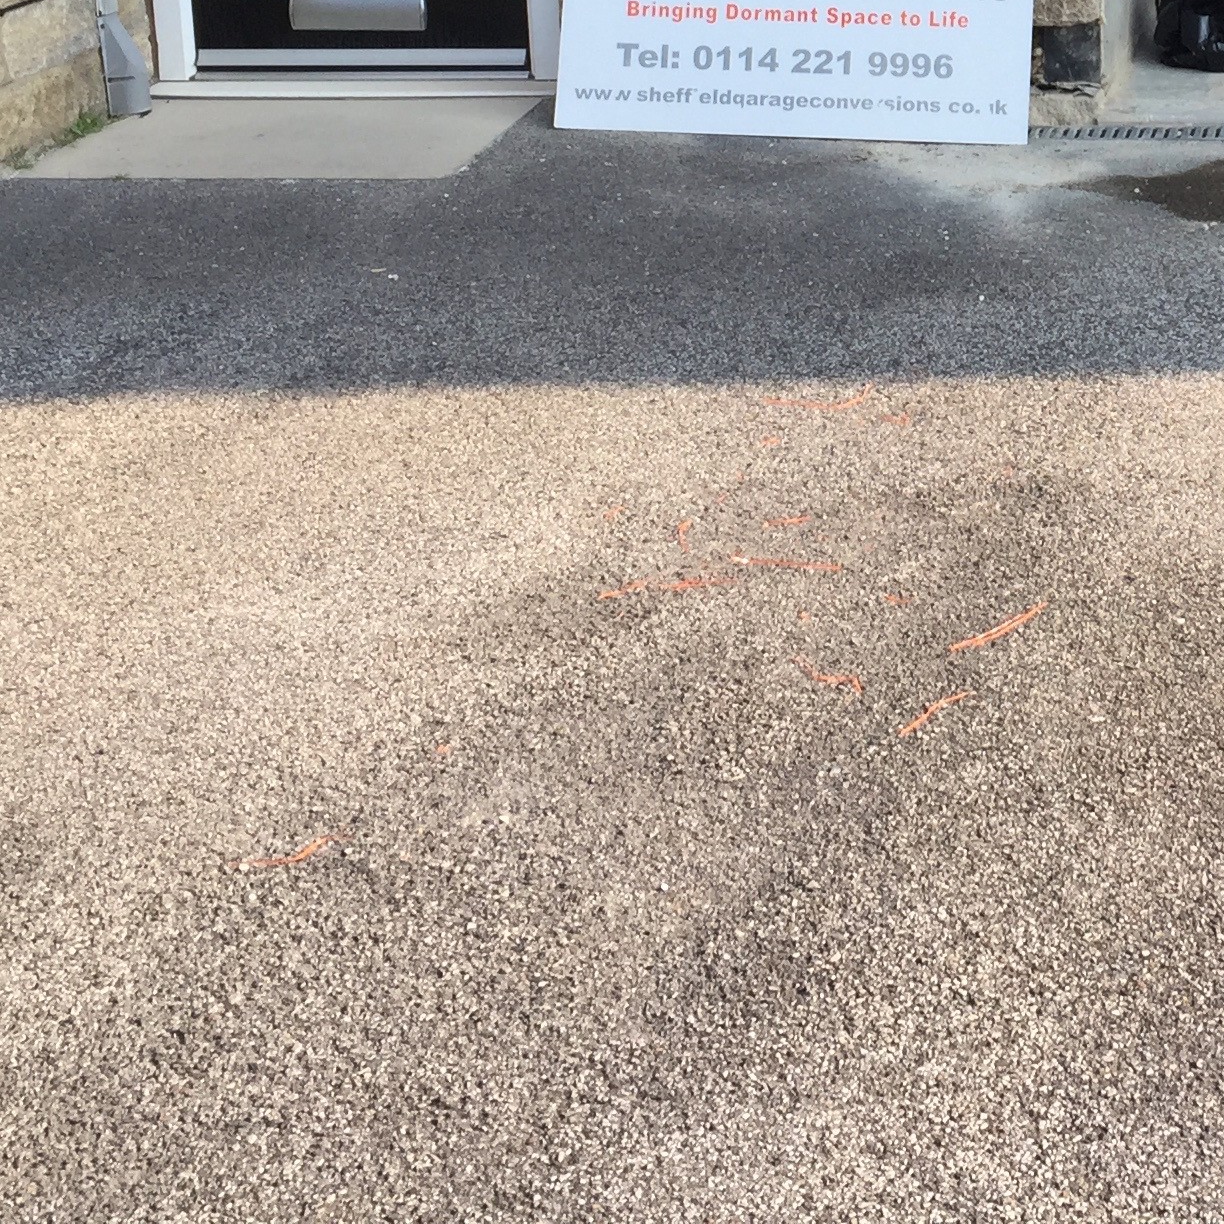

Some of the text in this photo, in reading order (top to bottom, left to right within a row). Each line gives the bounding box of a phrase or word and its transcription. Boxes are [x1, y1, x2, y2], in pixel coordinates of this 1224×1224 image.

[626, 0, 969, 29] Bringing Dormant Space to Life
[616, 42, 954, 79] Tel: 0114 221 9996
